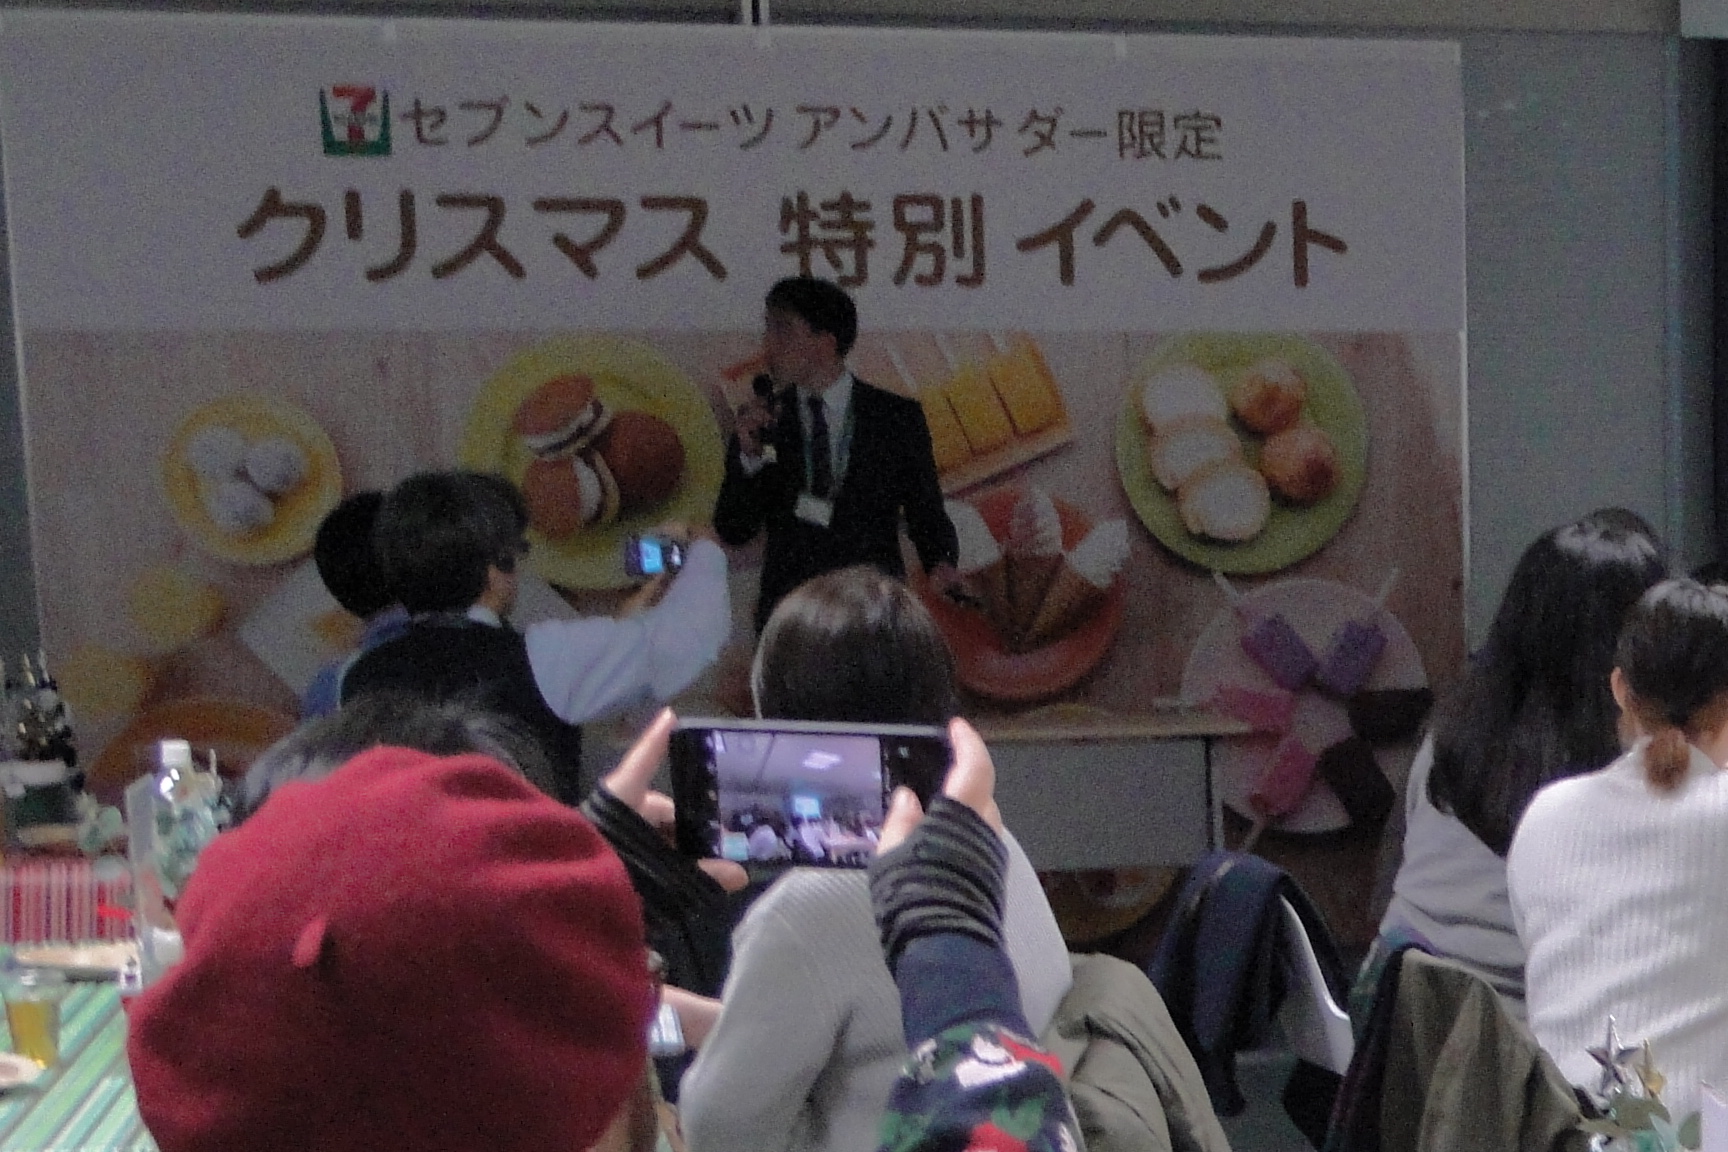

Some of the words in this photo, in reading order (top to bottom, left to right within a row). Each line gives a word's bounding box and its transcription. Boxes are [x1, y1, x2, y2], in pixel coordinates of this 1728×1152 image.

[403, 96, 775, 150] セブンスイーツ
[796, 104, 1223, 160] アンバサダー限定
[237, 185, 728, 283] クリスマス
[779, 190, 986, 288] 特別
[1015, 194, 1349, 288] イベント
